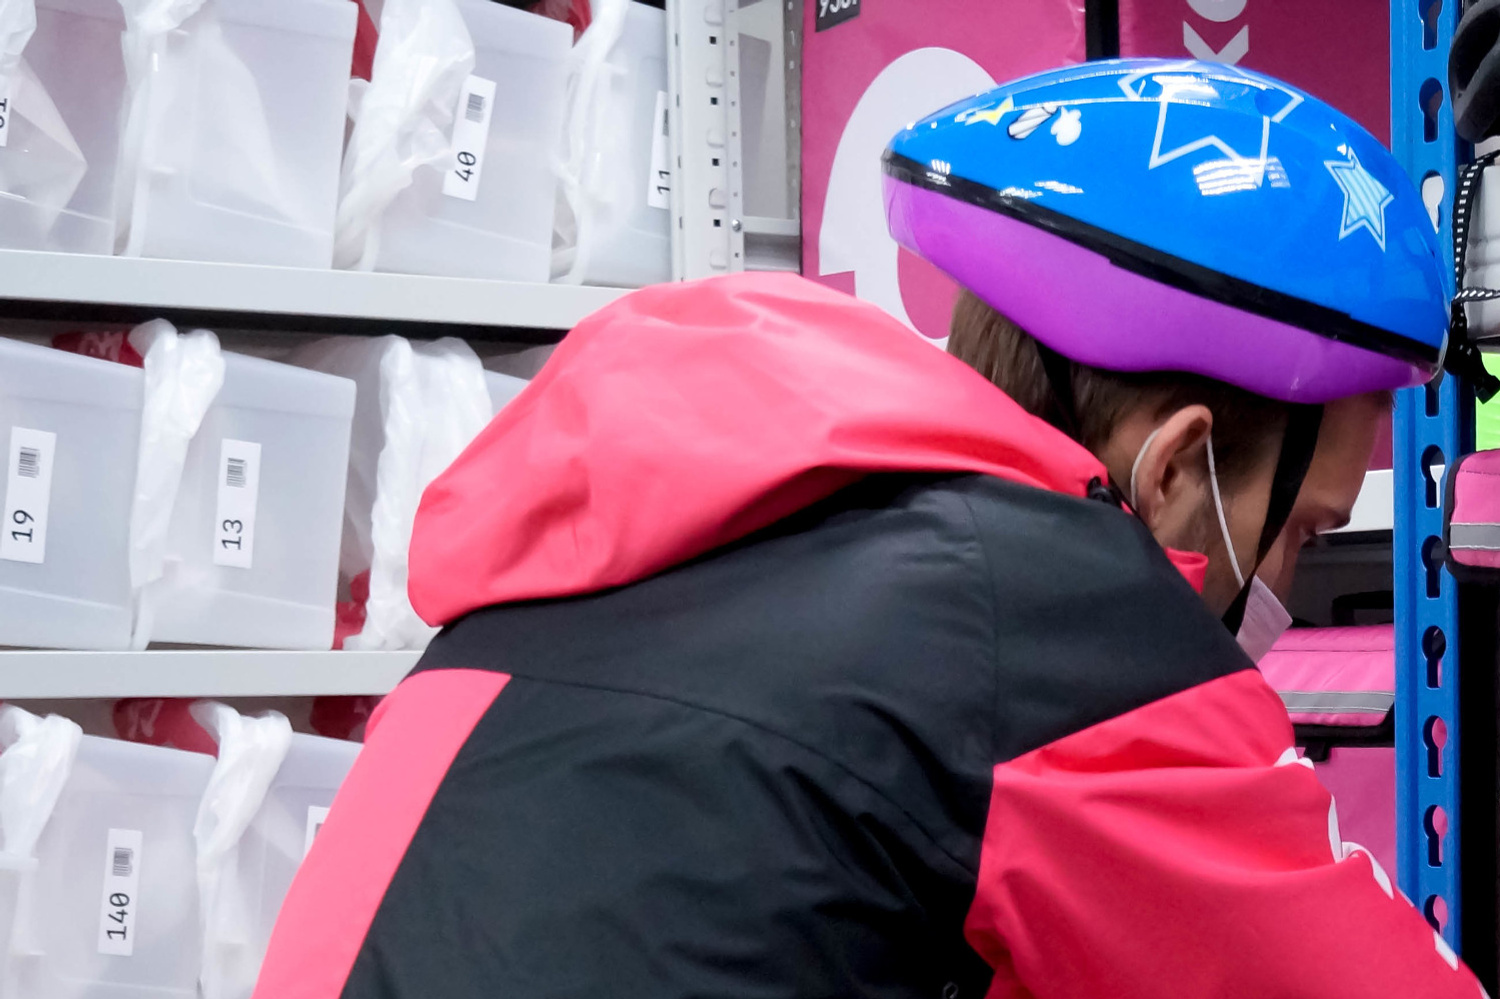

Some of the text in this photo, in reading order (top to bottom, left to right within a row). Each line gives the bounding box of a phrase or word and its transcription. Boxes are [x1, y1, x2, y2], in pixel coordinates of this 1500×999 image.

[455, 151, 476, 182] 40
[11, 509, 35, 543] 19
[221, 519, 243, 550] 13
[106, 892, 130, 941] 140
